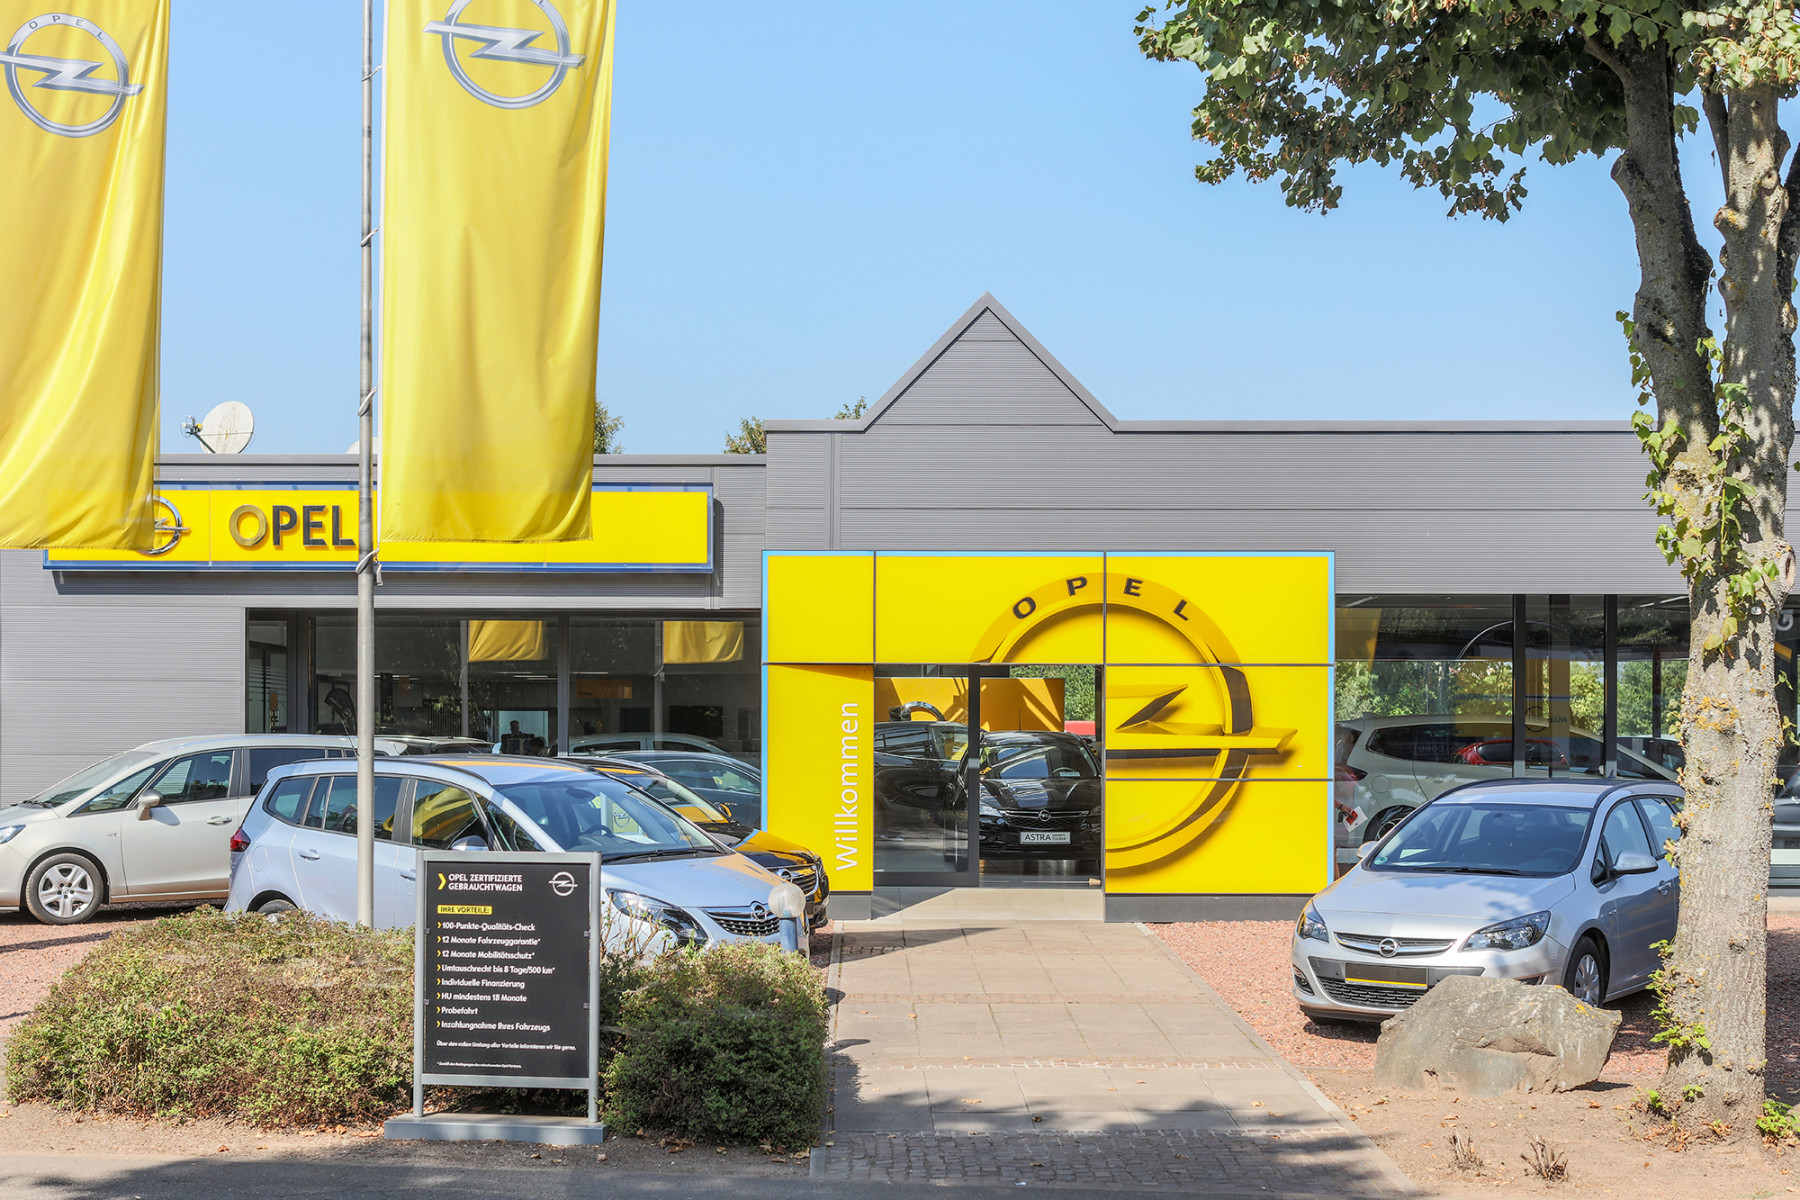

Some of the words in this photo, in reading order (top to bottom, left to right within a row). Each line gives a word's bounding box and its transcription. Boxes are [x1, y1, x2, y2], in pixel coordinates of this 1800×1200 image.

[28, 14, 104, 40] OPEL
[229, 504, 356, 547] OPEL
[1012, 576, 1190, 621] OPEL
[834, 702, 858, 871] Willkommen
[470, 874, 522, 882] ZERTIFIZIERTE
[448, 883, 522, 891] GEBRAUCHTWAGEN
[451, 936, 476, 944] Monate
[450, 950, 476, 958] Monate
[442, 964, 492, 972] Umtauschrecht
[493, 965, 503, 973] bis
[442, 978, 480, 986] Individuelle
[481, 979, 525, 989] Finanzierung
[453, 993, 491, 1001] mindestens
[501, 994, 527, 1002] Monate
[441, 1021, 497, 1030] Inzahlungnahme
[498, 1022, 514, 1030] Ihres
[516, 1023, 550, 1033] Fahrzeugs
